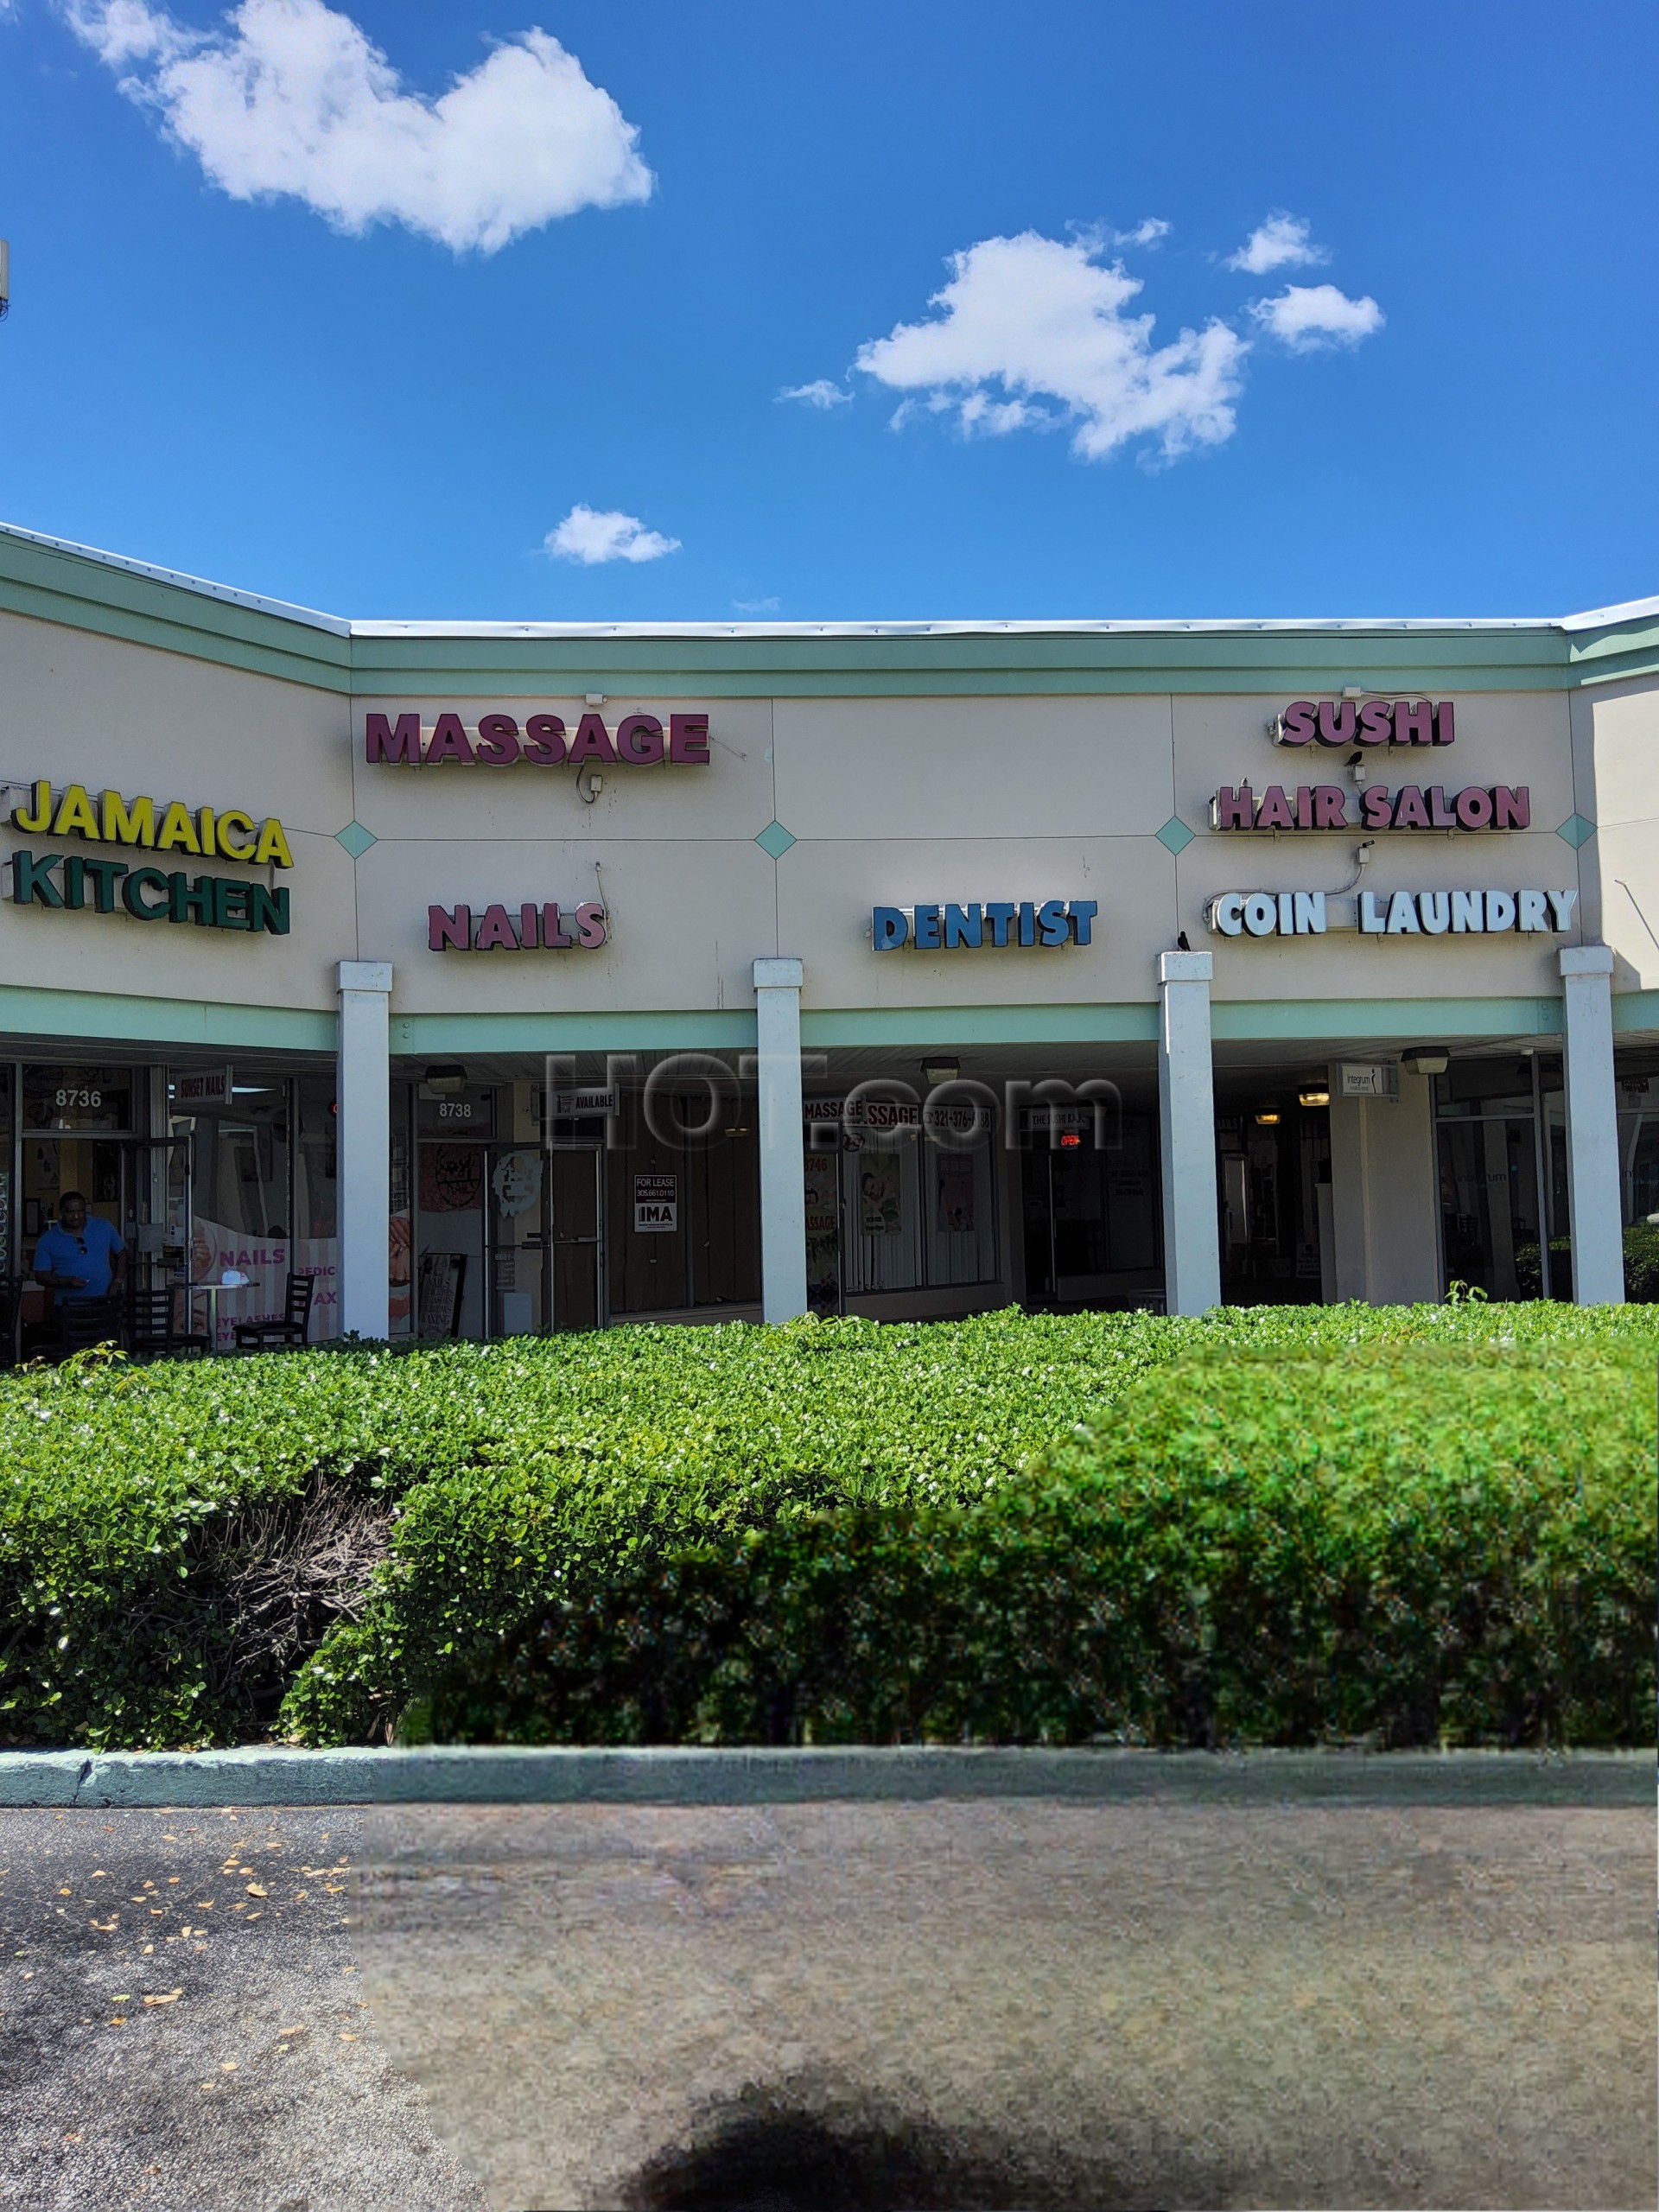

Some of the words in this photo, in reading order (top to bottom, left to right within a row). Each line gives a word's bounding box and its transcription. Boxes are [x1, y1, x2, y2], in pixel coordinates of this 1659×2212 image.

[1277, 700, 1454, 748] SUSHI
[365, 712, 709, 766] MASSAGE
[1217, 786, 1347, 830] HAIR
[1361, 785, 1530, 831] SALON
[11, 779, 294, 869] JAMAICA
[11, 849, 291, 936] KITCHEN
[1214, 891, 1327, 937] COIN
[1358, 889, 1578, 937] LAUNDRY
[429, 901, 607, 951] NAILS
[872, 899, 1098, 952] DENTIST
[181, 1077, 204, 1098] SUNSET
[206, 1075, 225, 1096] NAILS
[55, 1089, 102, 1108] 8736
[575, 1094, 613, 1109] AVAILABLE
[439, 1103, 472, 1118] 8738
[804, 1100, 862, 1119] MASSAGE
[865, 1105, 918, 1125] SSAGE
[1060, 1135, 1080, 1147] OPEN
[637, 1178, 652, 1187] FOR
[652, 1178, 675, 1187] LEASE
[637, 1189, 675, 1198] 305.661.0110
[639, 1206, 673, 1222] IMA
[805, 1216, 836, 1230] ASSAGE
[219, 1249, 285, 1267] NAILS
